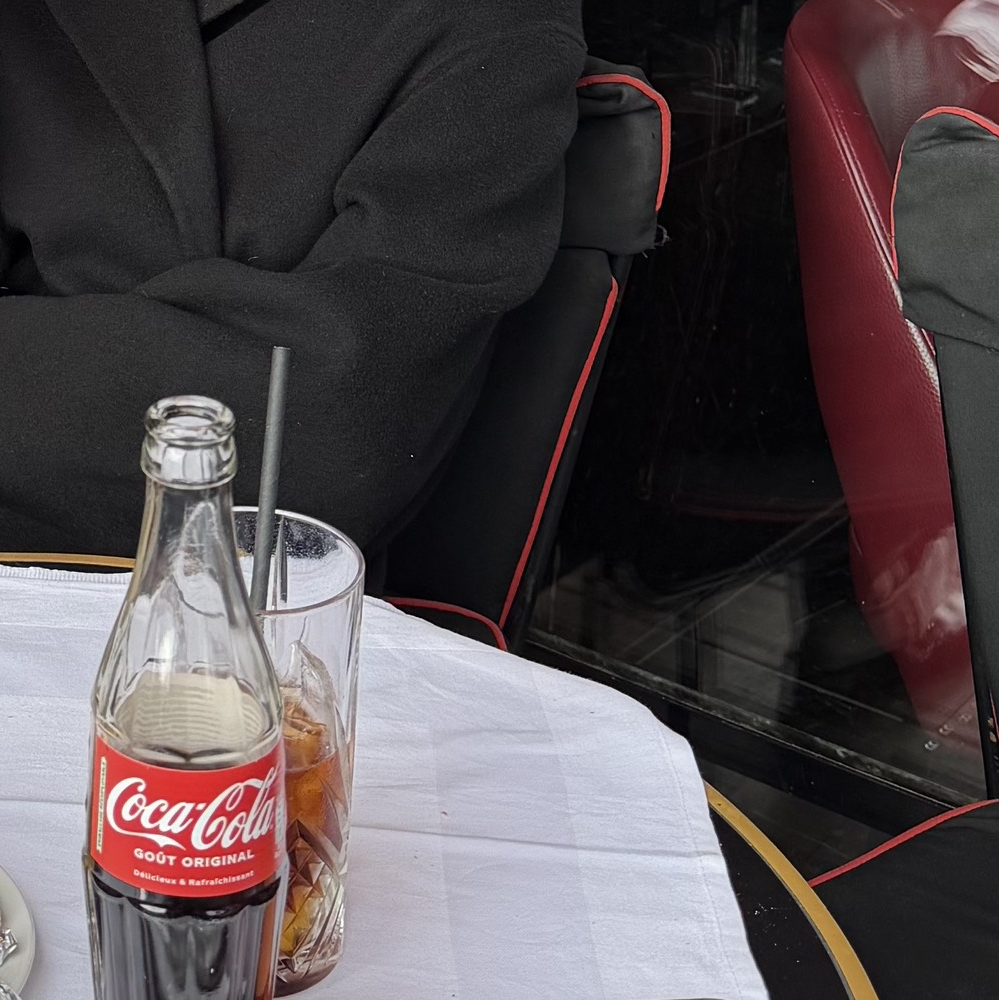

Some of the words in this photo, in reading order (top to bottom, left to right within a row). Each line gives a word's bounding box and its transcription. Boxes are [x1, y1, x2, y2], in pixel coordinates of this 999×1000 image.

[106, 766, 278, 851] Coca-Cola
[134, 848, 177, 866] GOÛT
[181, 849, 255, 868] ORIGINAL
[133, 869, 177, 885] Délicieux
[179, 878, 187, 886] &
